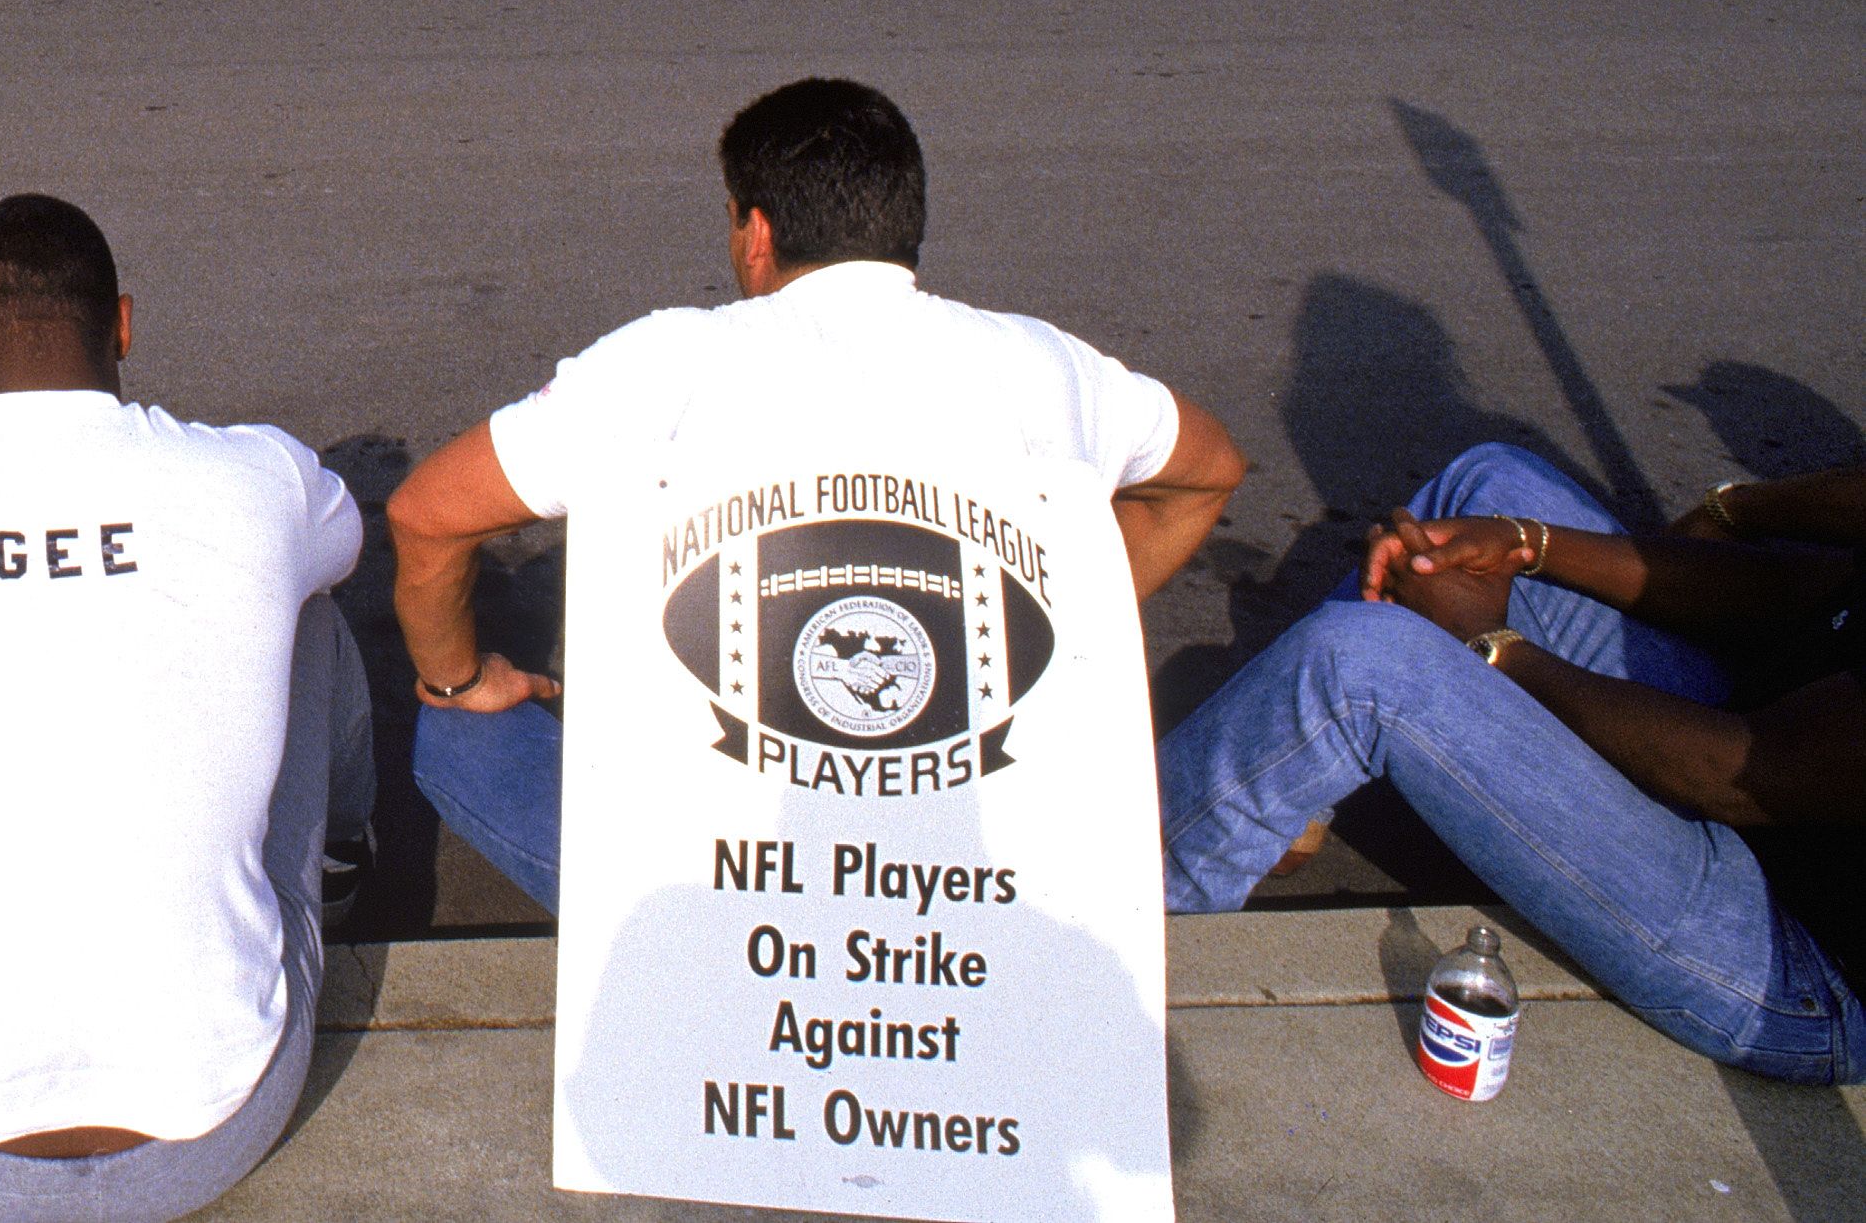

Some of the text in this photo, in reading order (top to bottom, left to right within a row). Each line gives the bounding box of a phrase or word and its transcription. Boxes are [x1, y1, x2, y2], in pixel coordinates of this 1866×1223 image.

[662, 474, 1052, 609] NATIONAL FOOTBALL LEAGUE
[802, 608, 837, 648] AMERICAN
[839, 600, 894, 614] FEDERATION
[897, 611, 909, 622] OF
[908, 622, 928, 648] LABOR
[797, 659, 932, 732] CONGRESS OF INDUSTRIAL ORGANIZATIONS
[816, 660, 839, 671] AFL
[895, 661, 917, 672] CIO
[759, 731, 973, 797] PLAYERS
[713, 839, 1016, 916] NFL Players
[747, 924, 987, 988] On Strike
[769, 1001, 961, 1070] Against
[1423, 1014, 1481, 1054] EPSI
[704, 1081, 1020, 1156] NFL Owners
